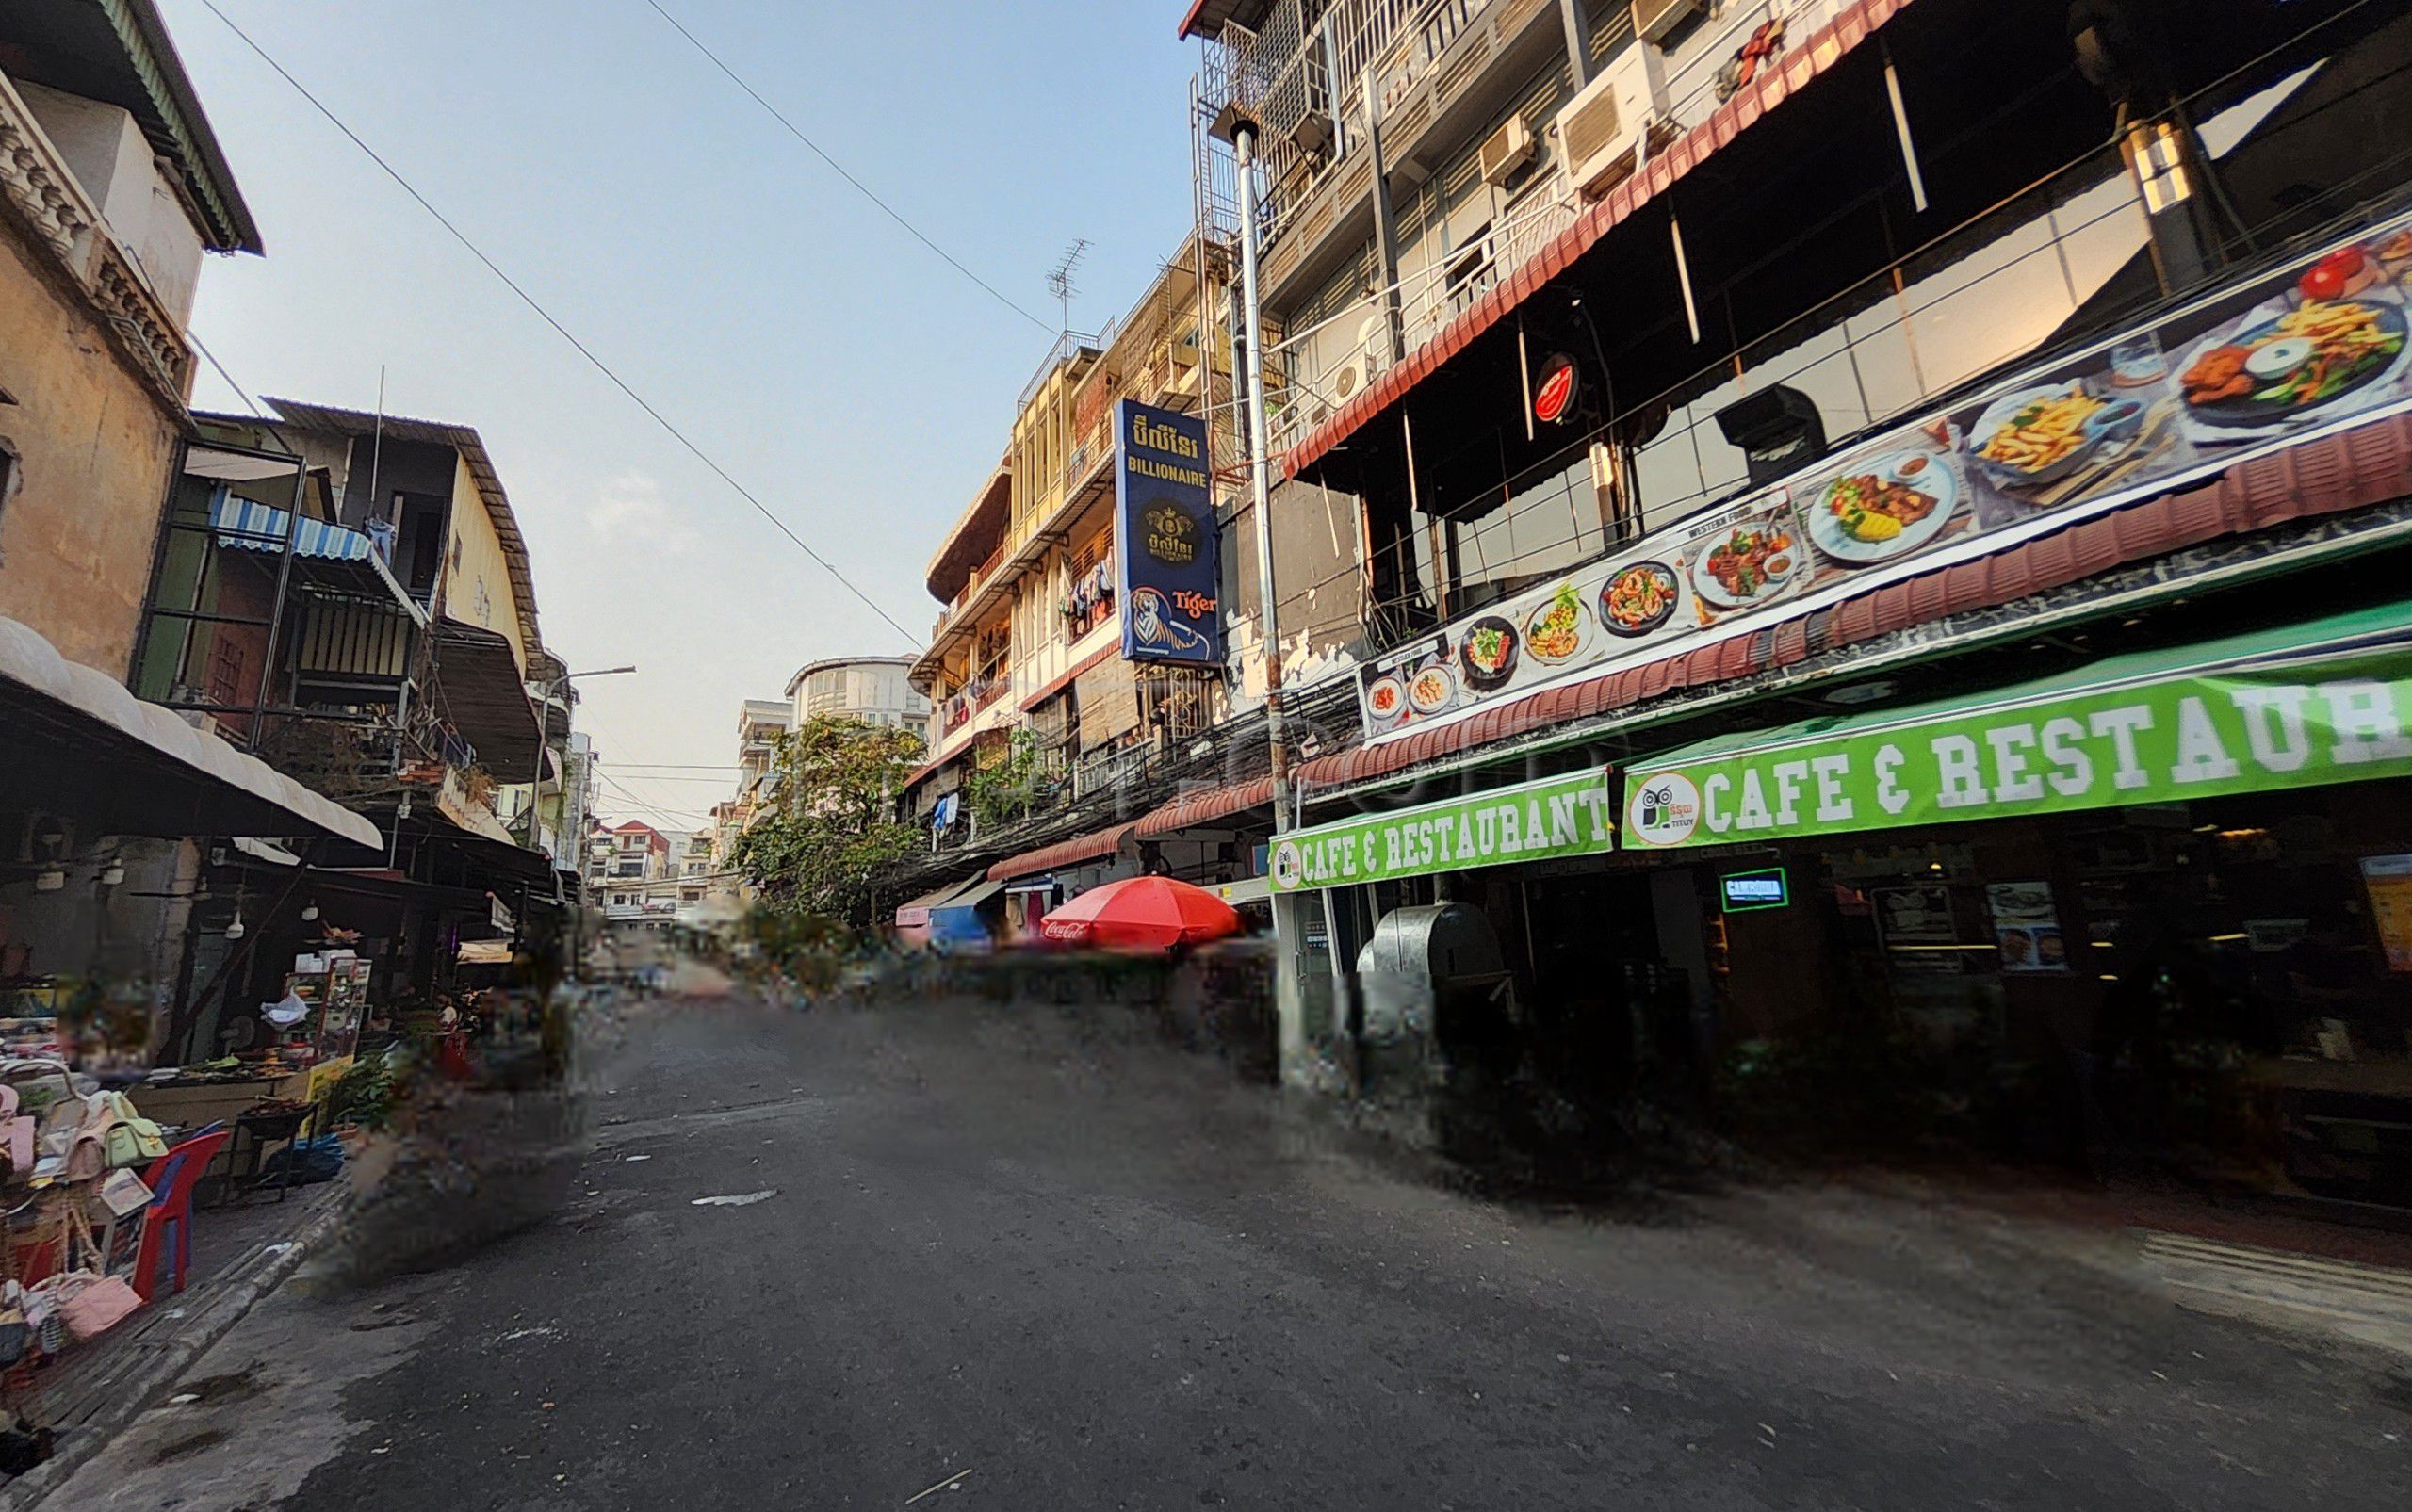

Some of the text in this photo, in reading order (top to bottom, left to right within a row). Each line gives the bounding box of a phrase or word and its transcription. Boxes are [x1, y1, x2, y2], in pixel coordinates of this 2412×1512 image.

[1128, 455, 1207, 488] BILLIONAIRE
[1172, 590, 1216, 619] Tiger
[1704, 754, 1854, 833] CAFE
[1302, 835, 1357, 882] CAFE
[1384, 787, 1607, 870] RESTAURANT
[1671, 819, 1694, 828] TITUY
